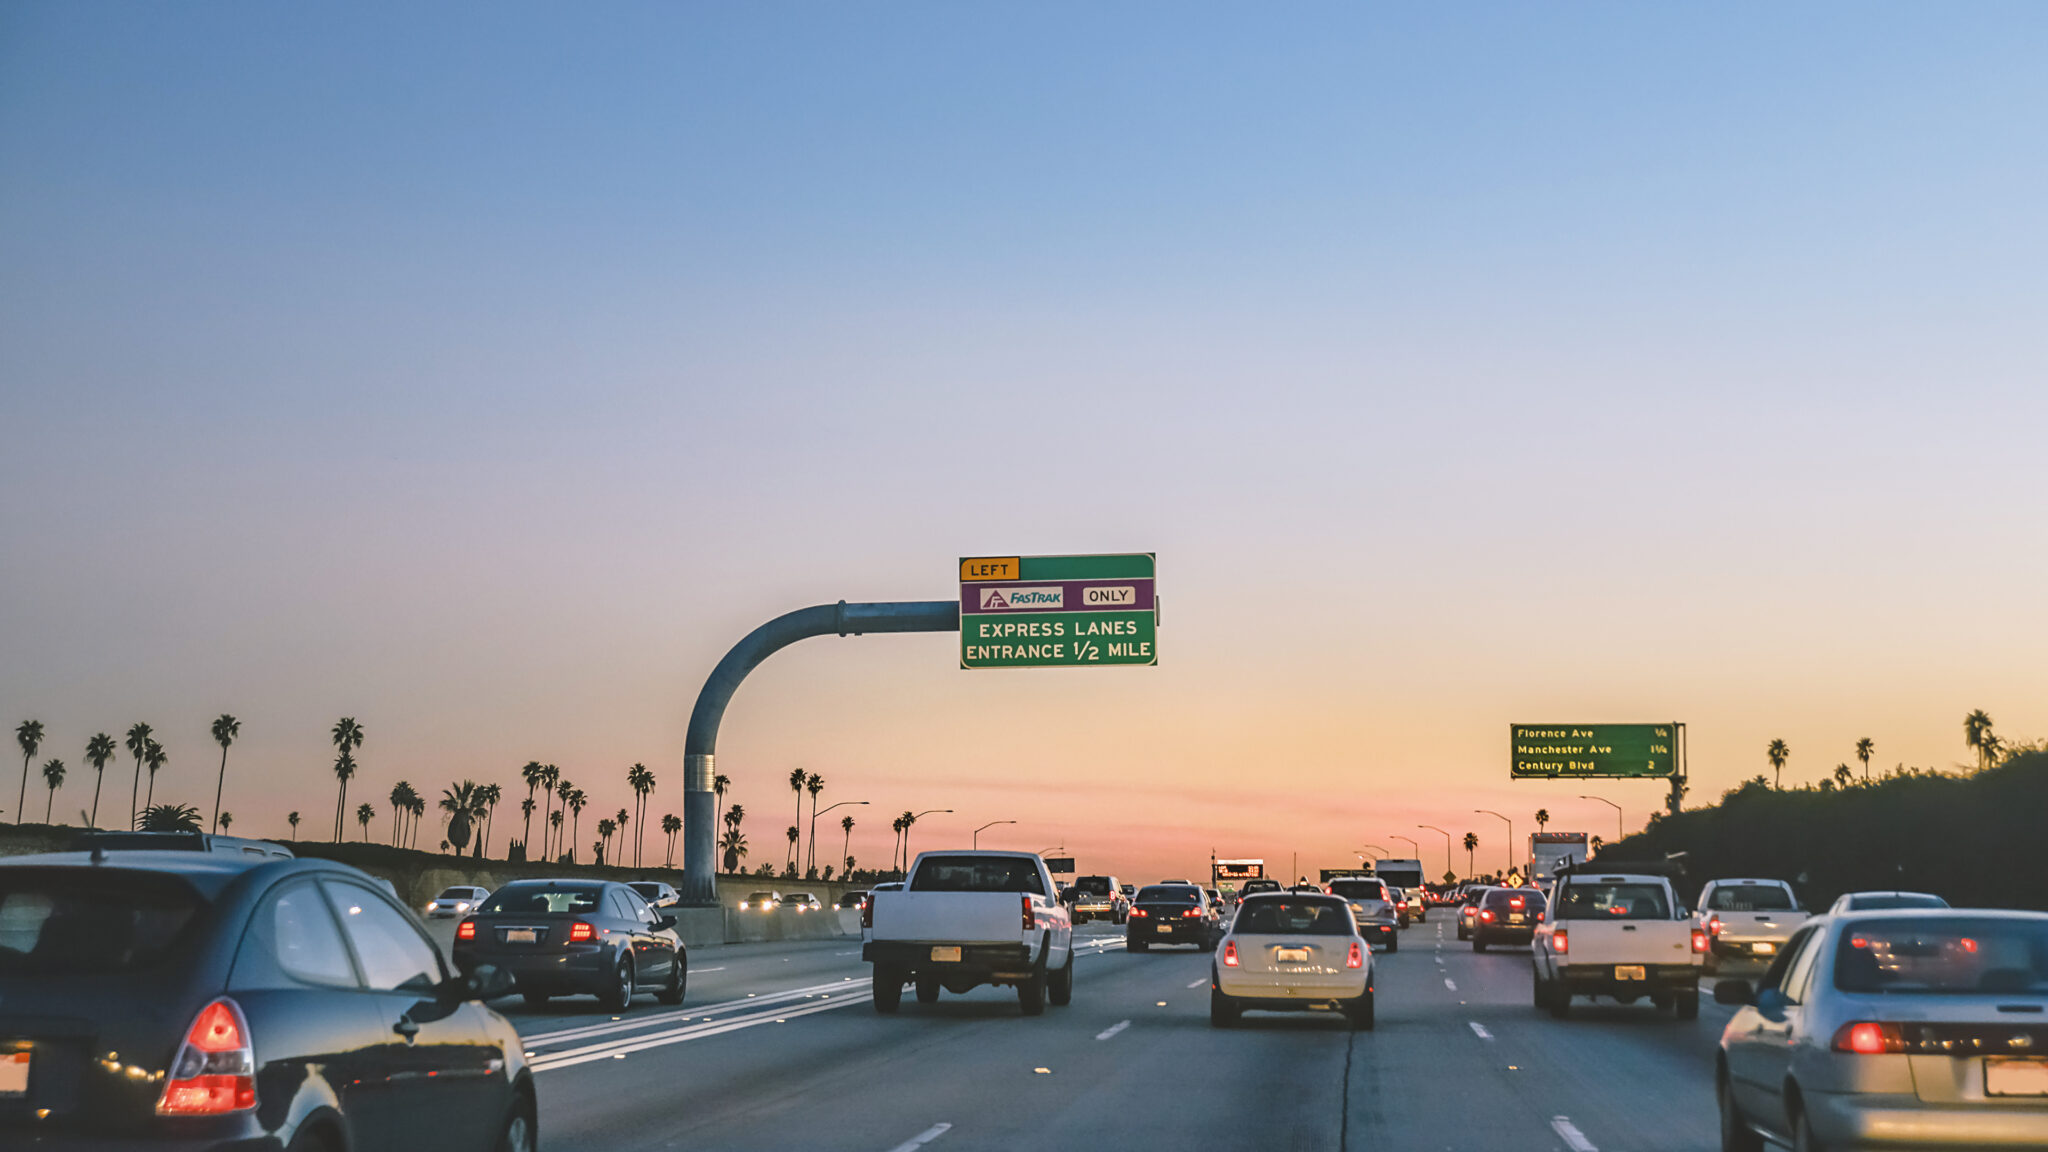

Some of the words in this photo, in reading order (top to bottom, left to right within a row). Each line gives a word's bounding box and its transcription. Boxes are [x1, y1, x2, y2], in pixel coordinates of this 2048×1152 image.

[971, 564, 1008, 576] LEFT
[1089, 590, 1129, 602] ONLY
[979, 622, 1065, 638] EXPRESS
[1075, 621, 1137, 636] LANES
[967, 644, 1064, 660] ENTRANCE
[1073, 641, 1099, 661] 1/2
[1108, 642, 1151, 657] MILE
[1518, 729, 1566, 738] Florence
[1572, 729, 1594, 738] Ave
[1518, 745, 1584, 754] Manchester
[1589, 745, 1612, 754] Ave
[1518, 761, 1564, 772] Century
[1569, 761, 1595, 770] Blvd
[1648, 760, 1655, 770] 2
